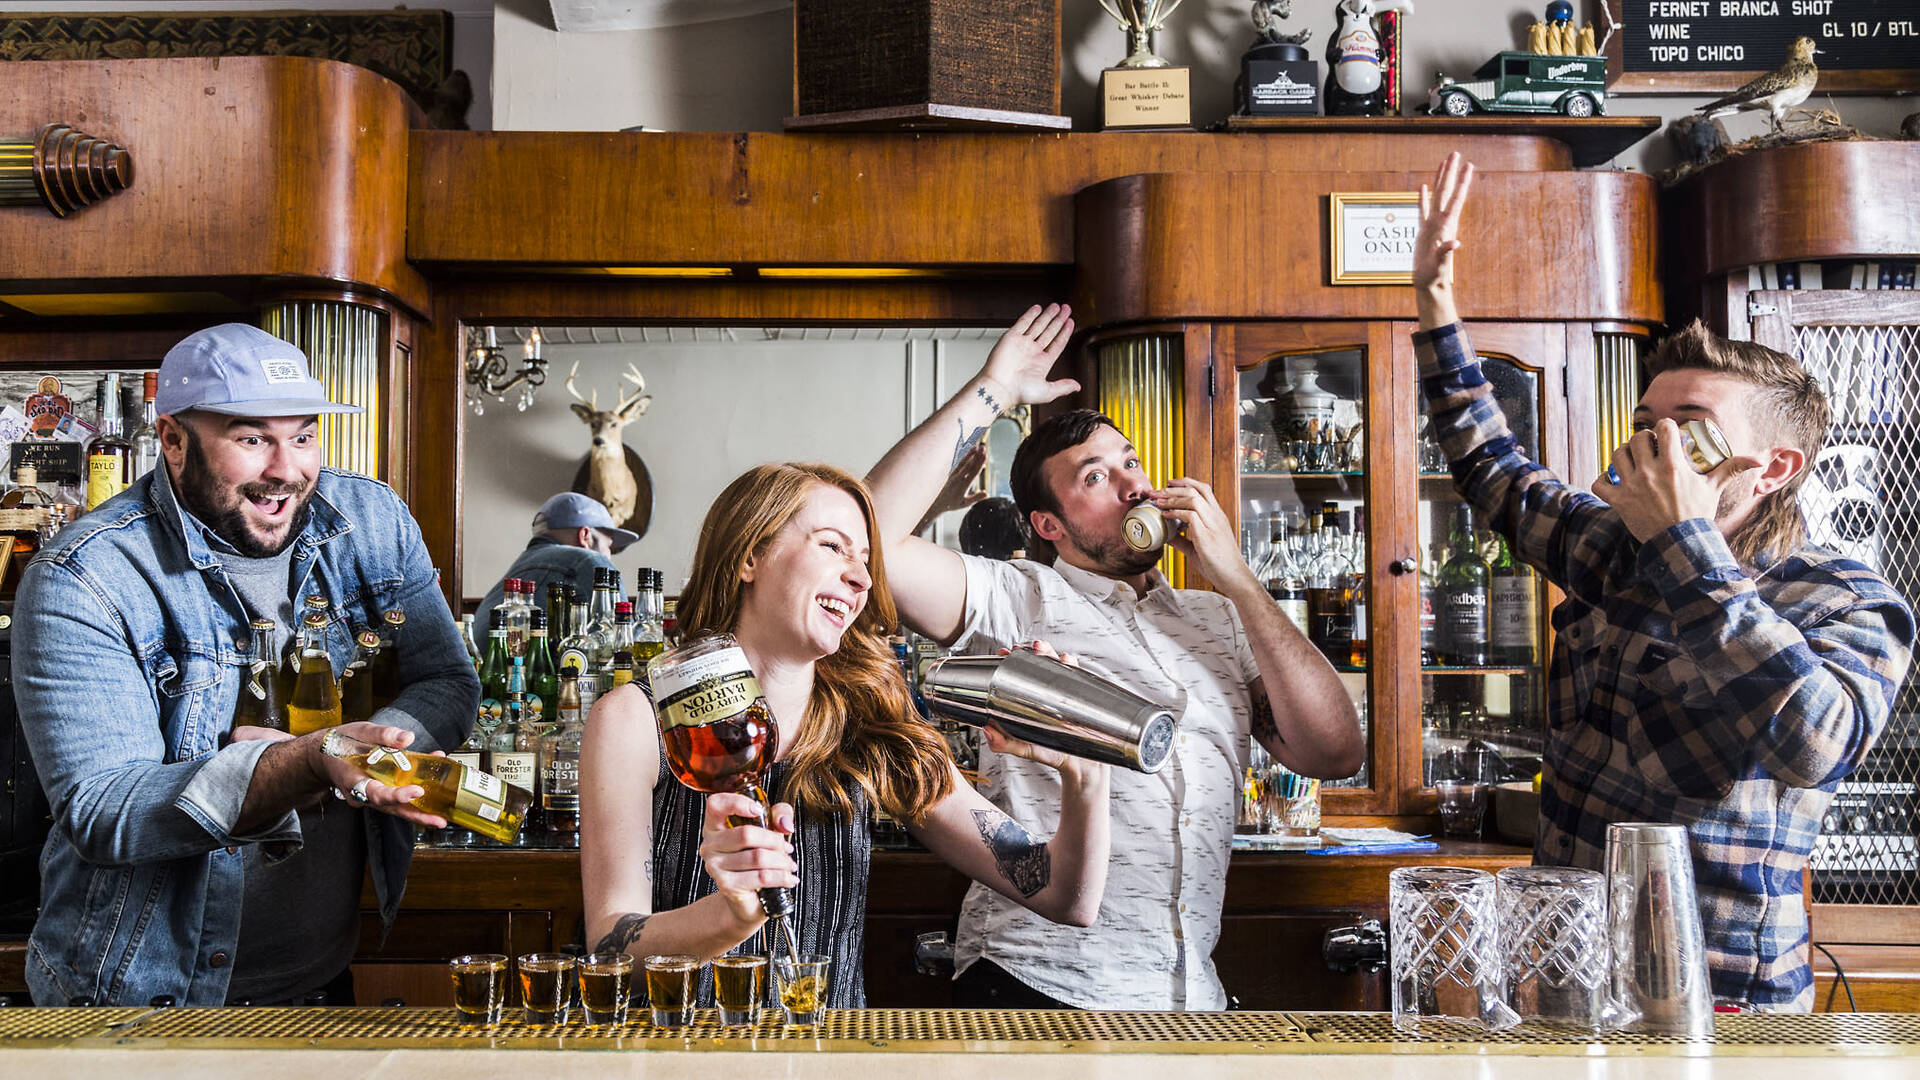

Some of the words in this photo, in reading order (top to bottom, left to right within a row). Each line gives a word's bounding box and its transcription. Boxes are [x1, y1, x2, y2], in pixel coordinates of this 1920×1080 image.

[1650, 1, 1710, 17] FERNET
[1720, 1, 1779, 17] BRANCA
[1792, 0, 1833, 16] SHOT
[1650, 23, 1691, 39] WINE
[1823, 22, 1844, 37] GL
[1851, 22, 1868, 37] 10
[1871, 22, 1881, 37] /
[1888, 21, 1919, 37] BTL
[1650, 46, 1689, 62] TOPO
[1697, 45, 1744, 61] CHICO
[1548, 62, 1588, 80] Underberg
[1363, 226, 1415, 240] CASH
[1364, 241, 1414, 254] ONLY
[90, 462, 116, 470] TAYLO
[683, 683, 746, 713] BARTON
[717, 695, 746, 707] VERY
[689, 704, 713, 718] OLD
[496, 764, 531, 773] FORESTER
[551, 760, 571, 770] OLD
